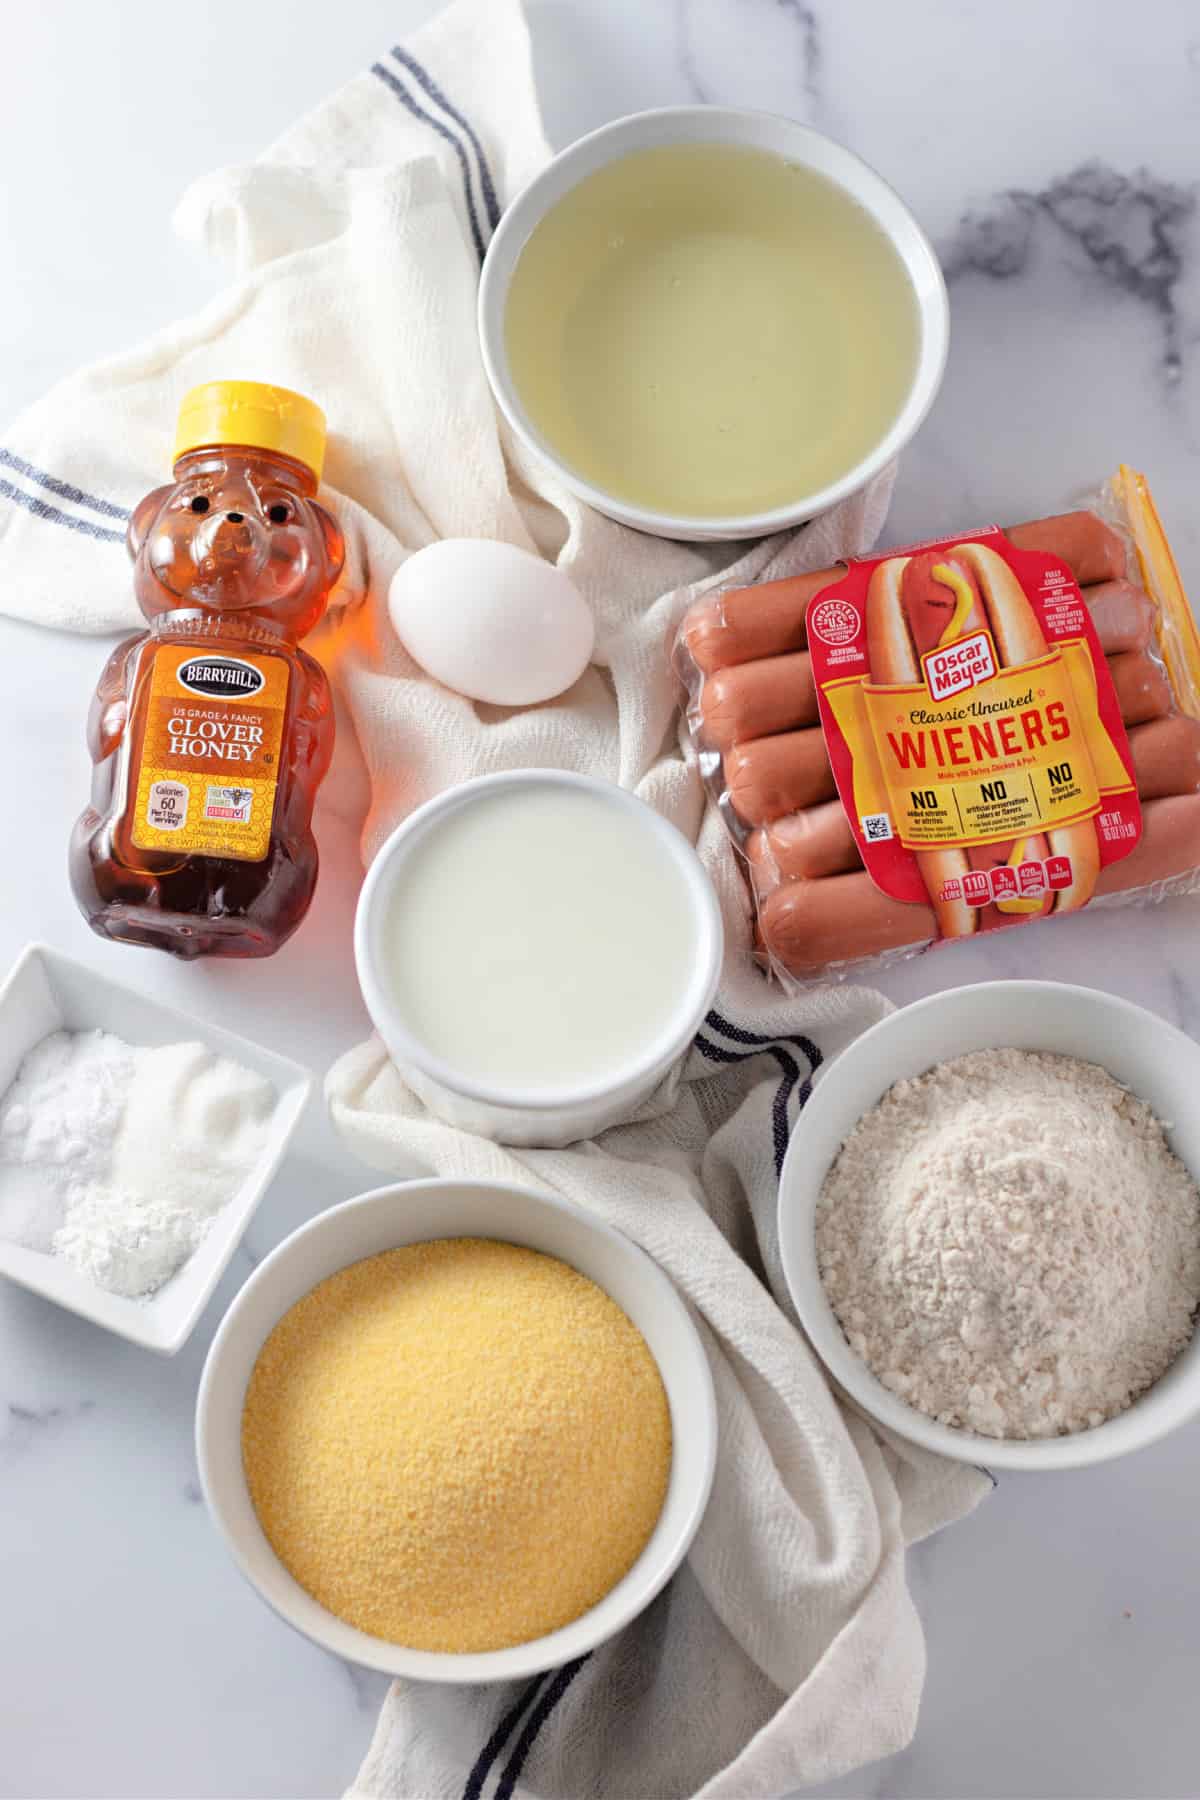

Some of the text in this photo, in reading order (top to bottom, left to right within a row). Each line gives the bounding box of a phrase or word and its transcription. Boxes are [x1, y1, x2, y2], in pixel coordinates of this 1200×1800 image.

[933, 642, 982, 674] Oscar
[187, 665, 255, 688] BERRYHILL
[934, 656, 989, 692] Mayer
[910, 688, 1033, 725] Classic Uncured
[187, 709, 219, 720] GRADE
[220, 713, 229, 721] A
[231, 713, 263, 725] FANCY
[167, 718, 264, 744] CLOVER
[886, 701, 1071, 768] WIENERS
[168, 736, 259, 761] HONEY
[1047, 762, 1073, 787] NO
[155, 785, 184, 797] Calories
[911, 791, 938, 809] NO
[980, 780, 1007, 802] NO
[161, 798, 176, 810] 60
[966, 797, 1028, 814] artificial preservatives
[976, 812, 994, 820] colors
[1002, 806, 1022, 816] flavors
[154, 817, 179, 828] serving
[944, 880, 959, 890] PER
[965, 876, 986, 892] 110
